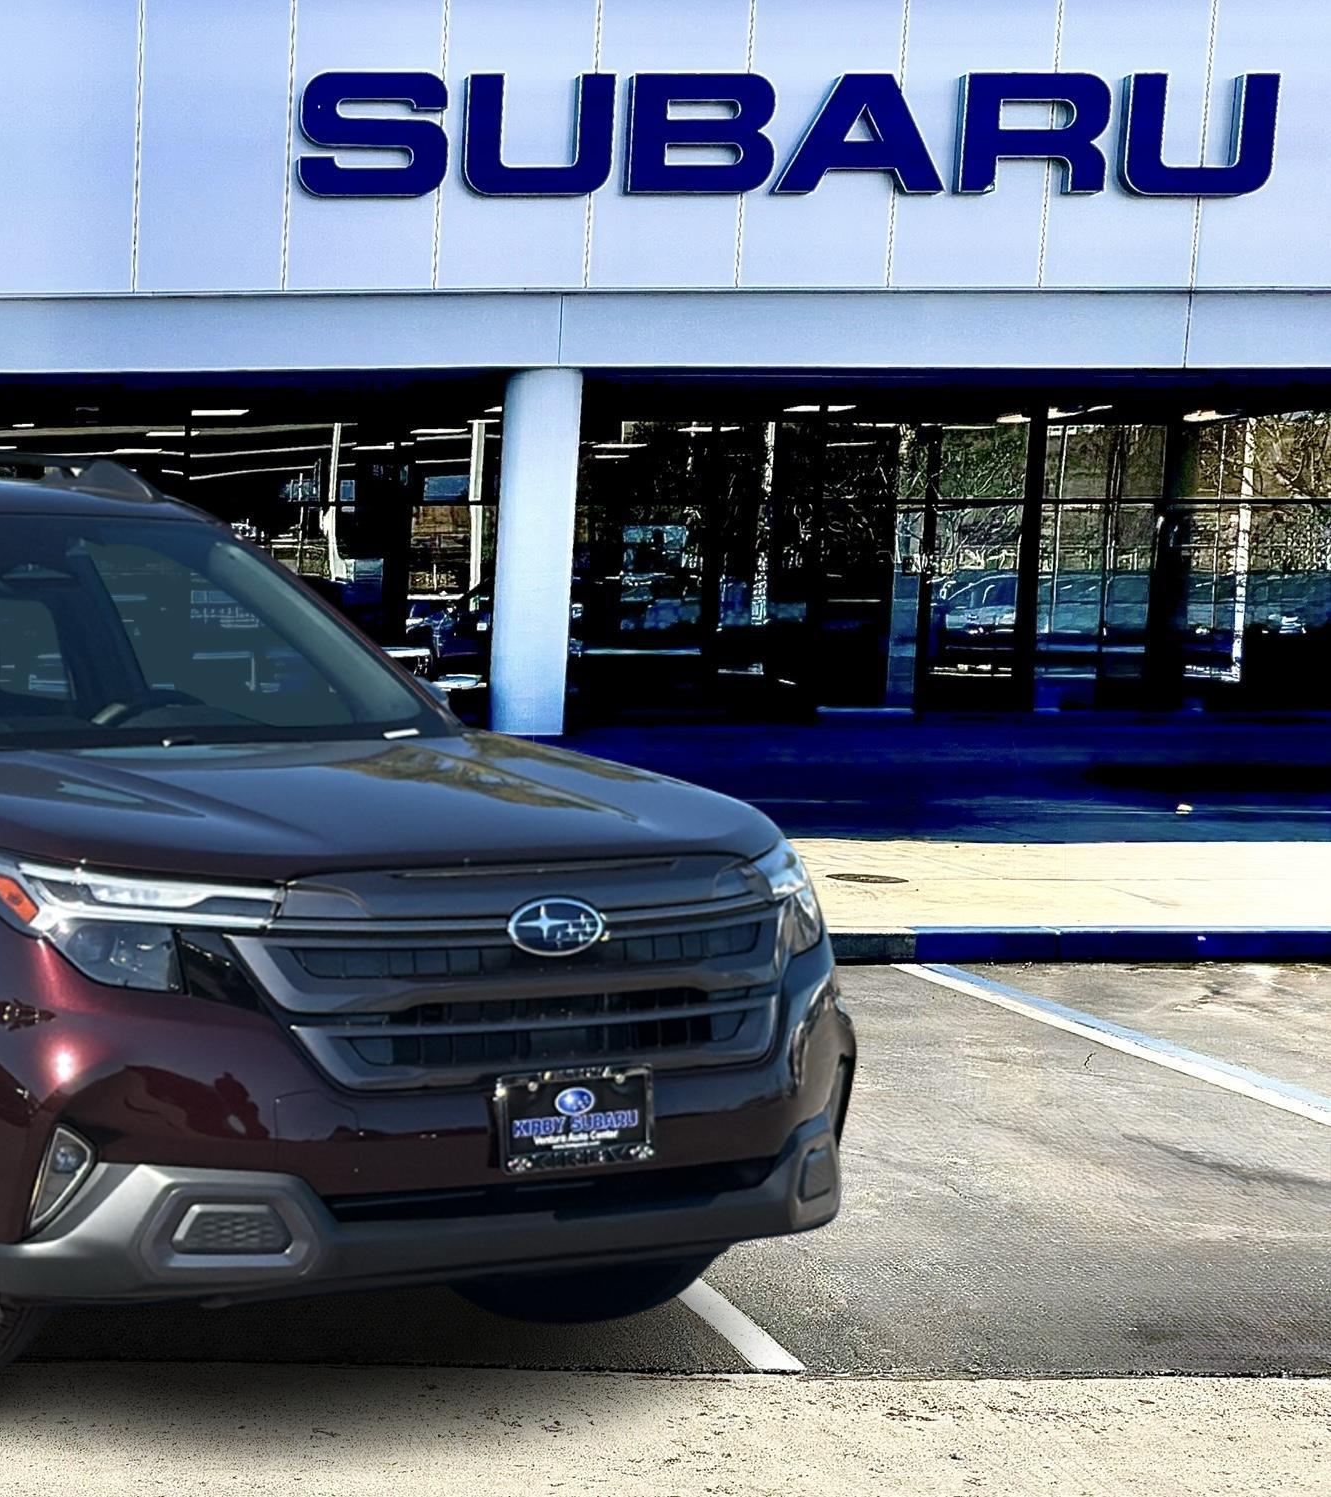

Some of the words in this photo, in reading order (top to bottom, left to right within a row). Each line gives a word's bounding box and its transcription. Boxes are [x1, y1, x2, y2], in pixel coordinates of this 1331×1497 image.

[296, 71, 1281, 198] SUBARU
[512, 1116, 566, 1138] KIRBY
[570, 1109, 639, 1132] SUBARU
[568, 1131, 588, 1142] Auto
[590, 1129, 619, 1140] Center
